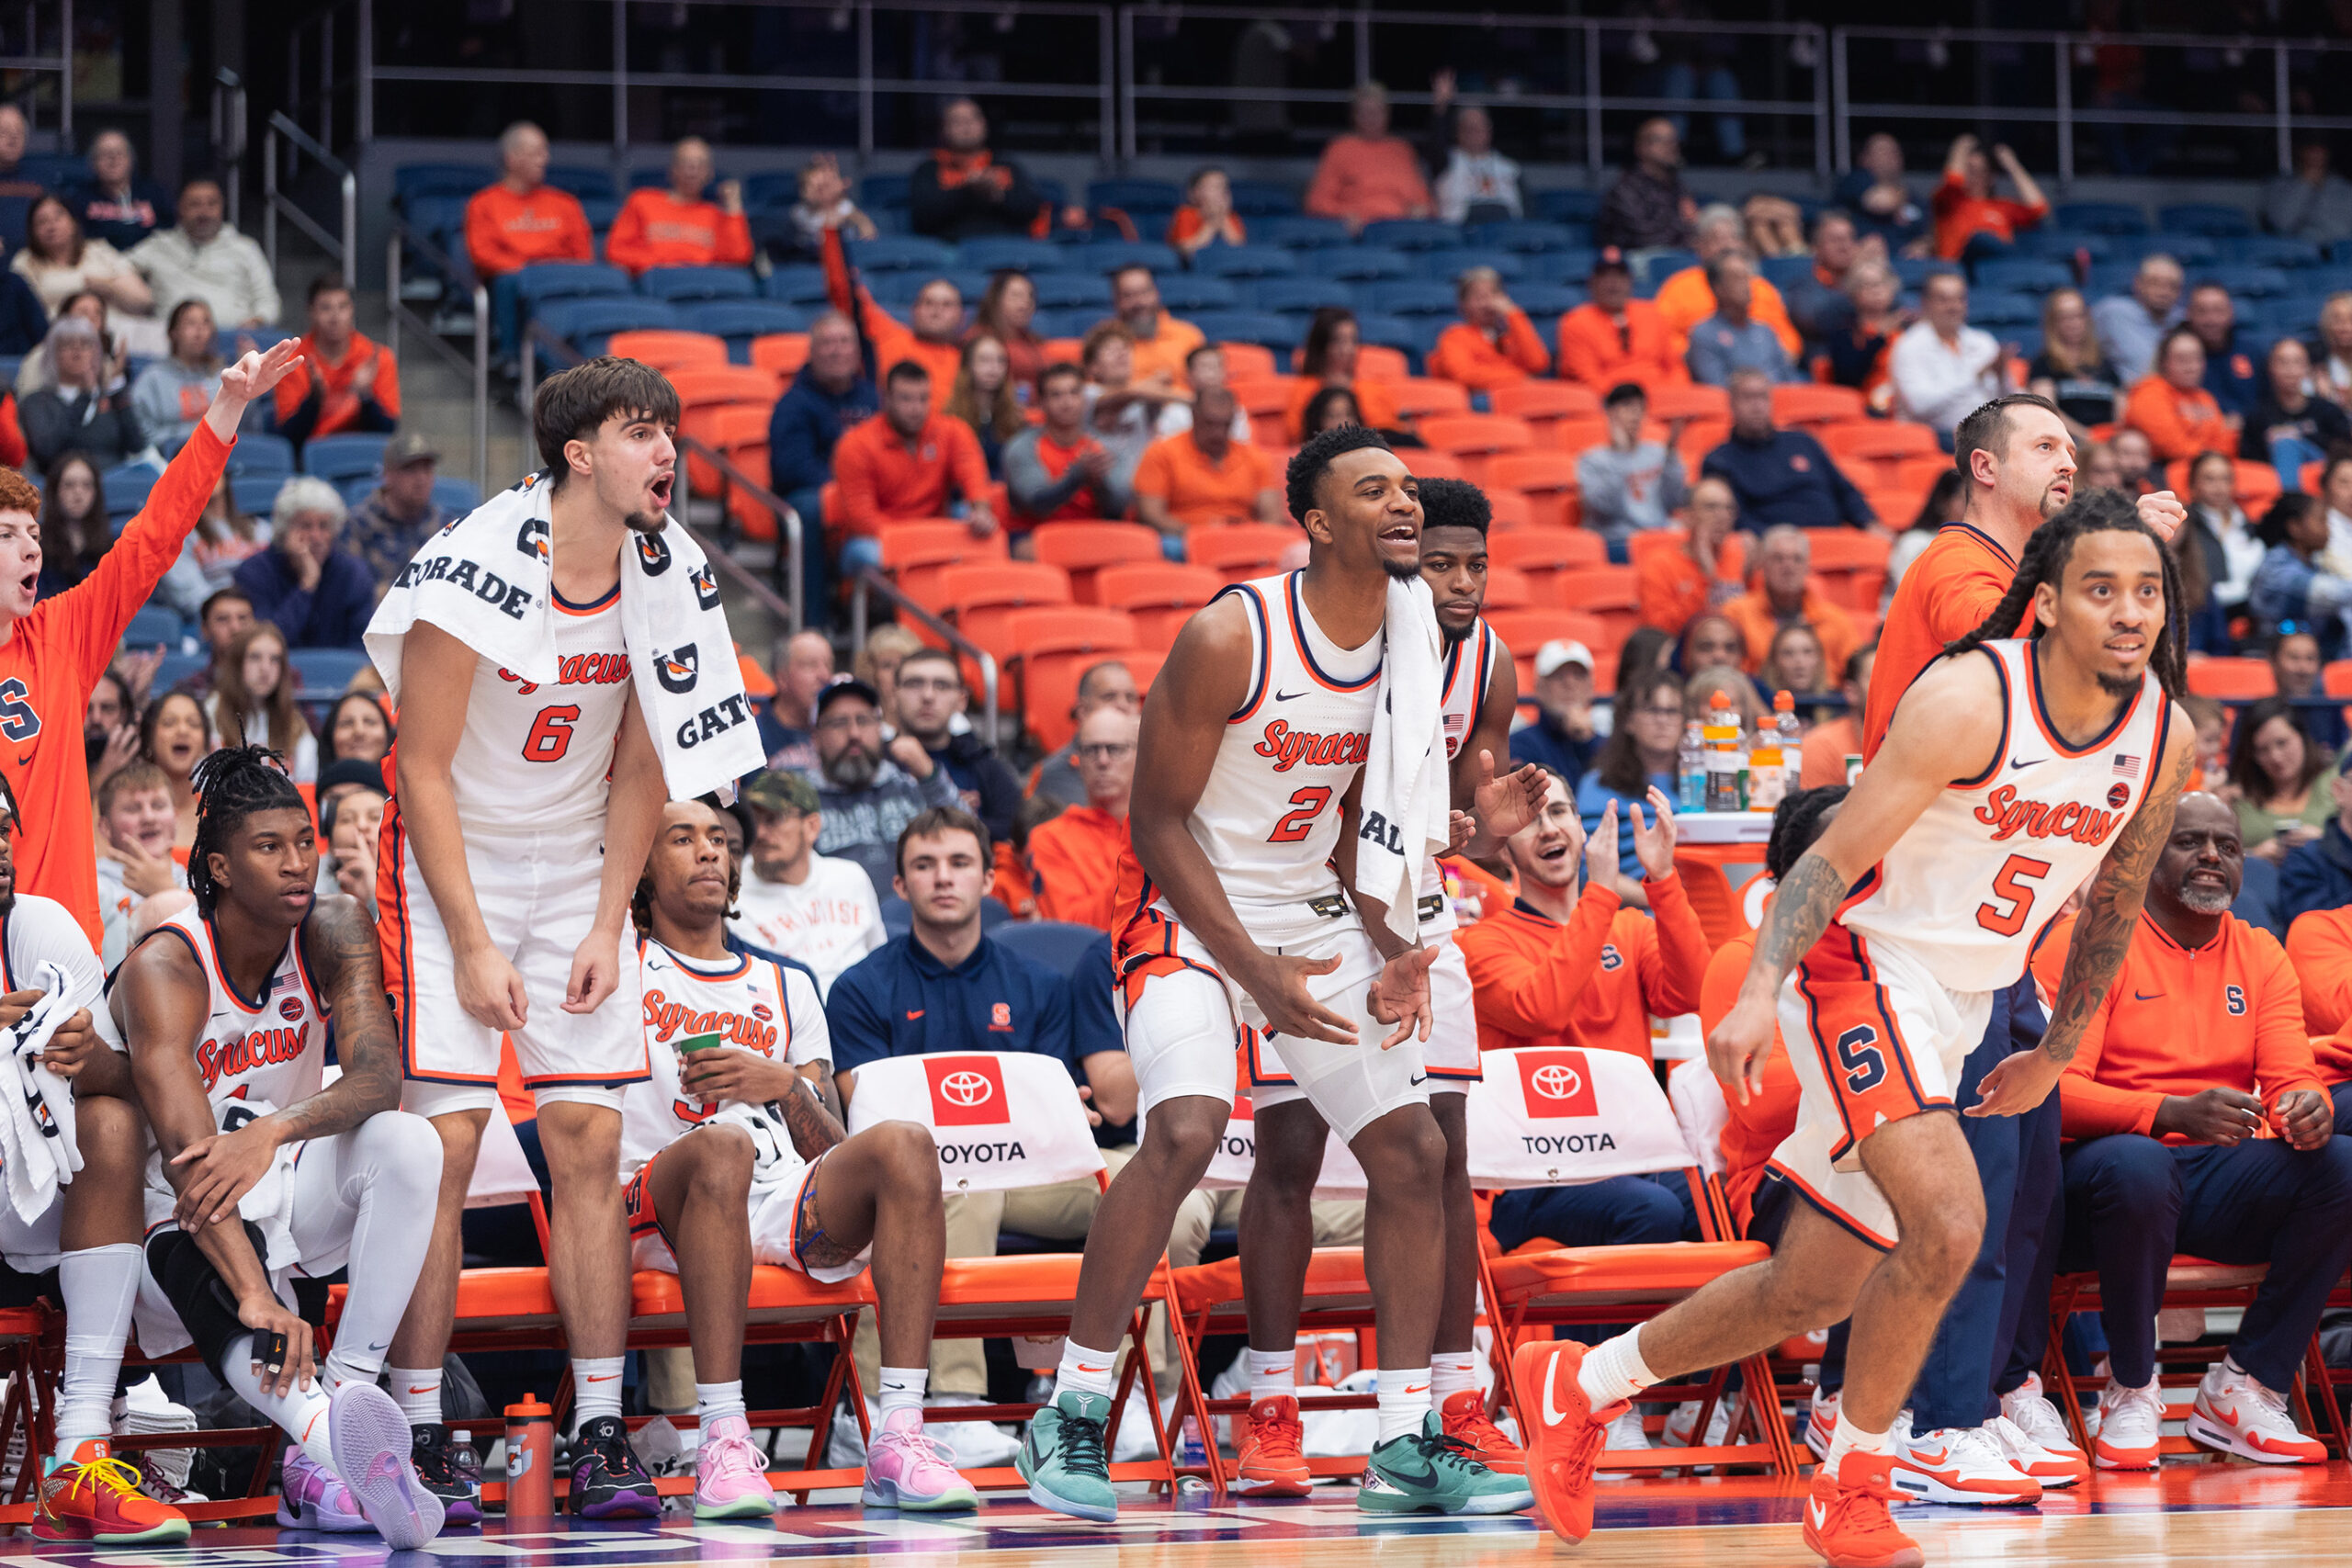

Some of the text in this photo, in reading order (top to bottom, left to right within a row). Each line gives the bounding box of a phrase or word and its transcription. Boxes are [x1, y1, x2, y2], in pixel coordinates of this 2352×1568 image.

[0, 676, 42, 742] S
[521, 704, 582, 762] 6
[676, 691, 755, 750] GAT
[1266, 785, 1333, 843] 2
[1975, 853, 2052, 938] 5
[1600, 943, 1624, 973] S
[643, 989, 777, 1057] Syracuse
[991, 1002, 1011, 1027] S
[2225, 984, 2247, 1016] S
[197, 1021, 310, 1094] Syracuse
[1836, 1022, 1889, 1095] S
[935, 1141, 1026, 1164] OYOTA
[1521, 1133, 1617, 1155] TOYOTA
